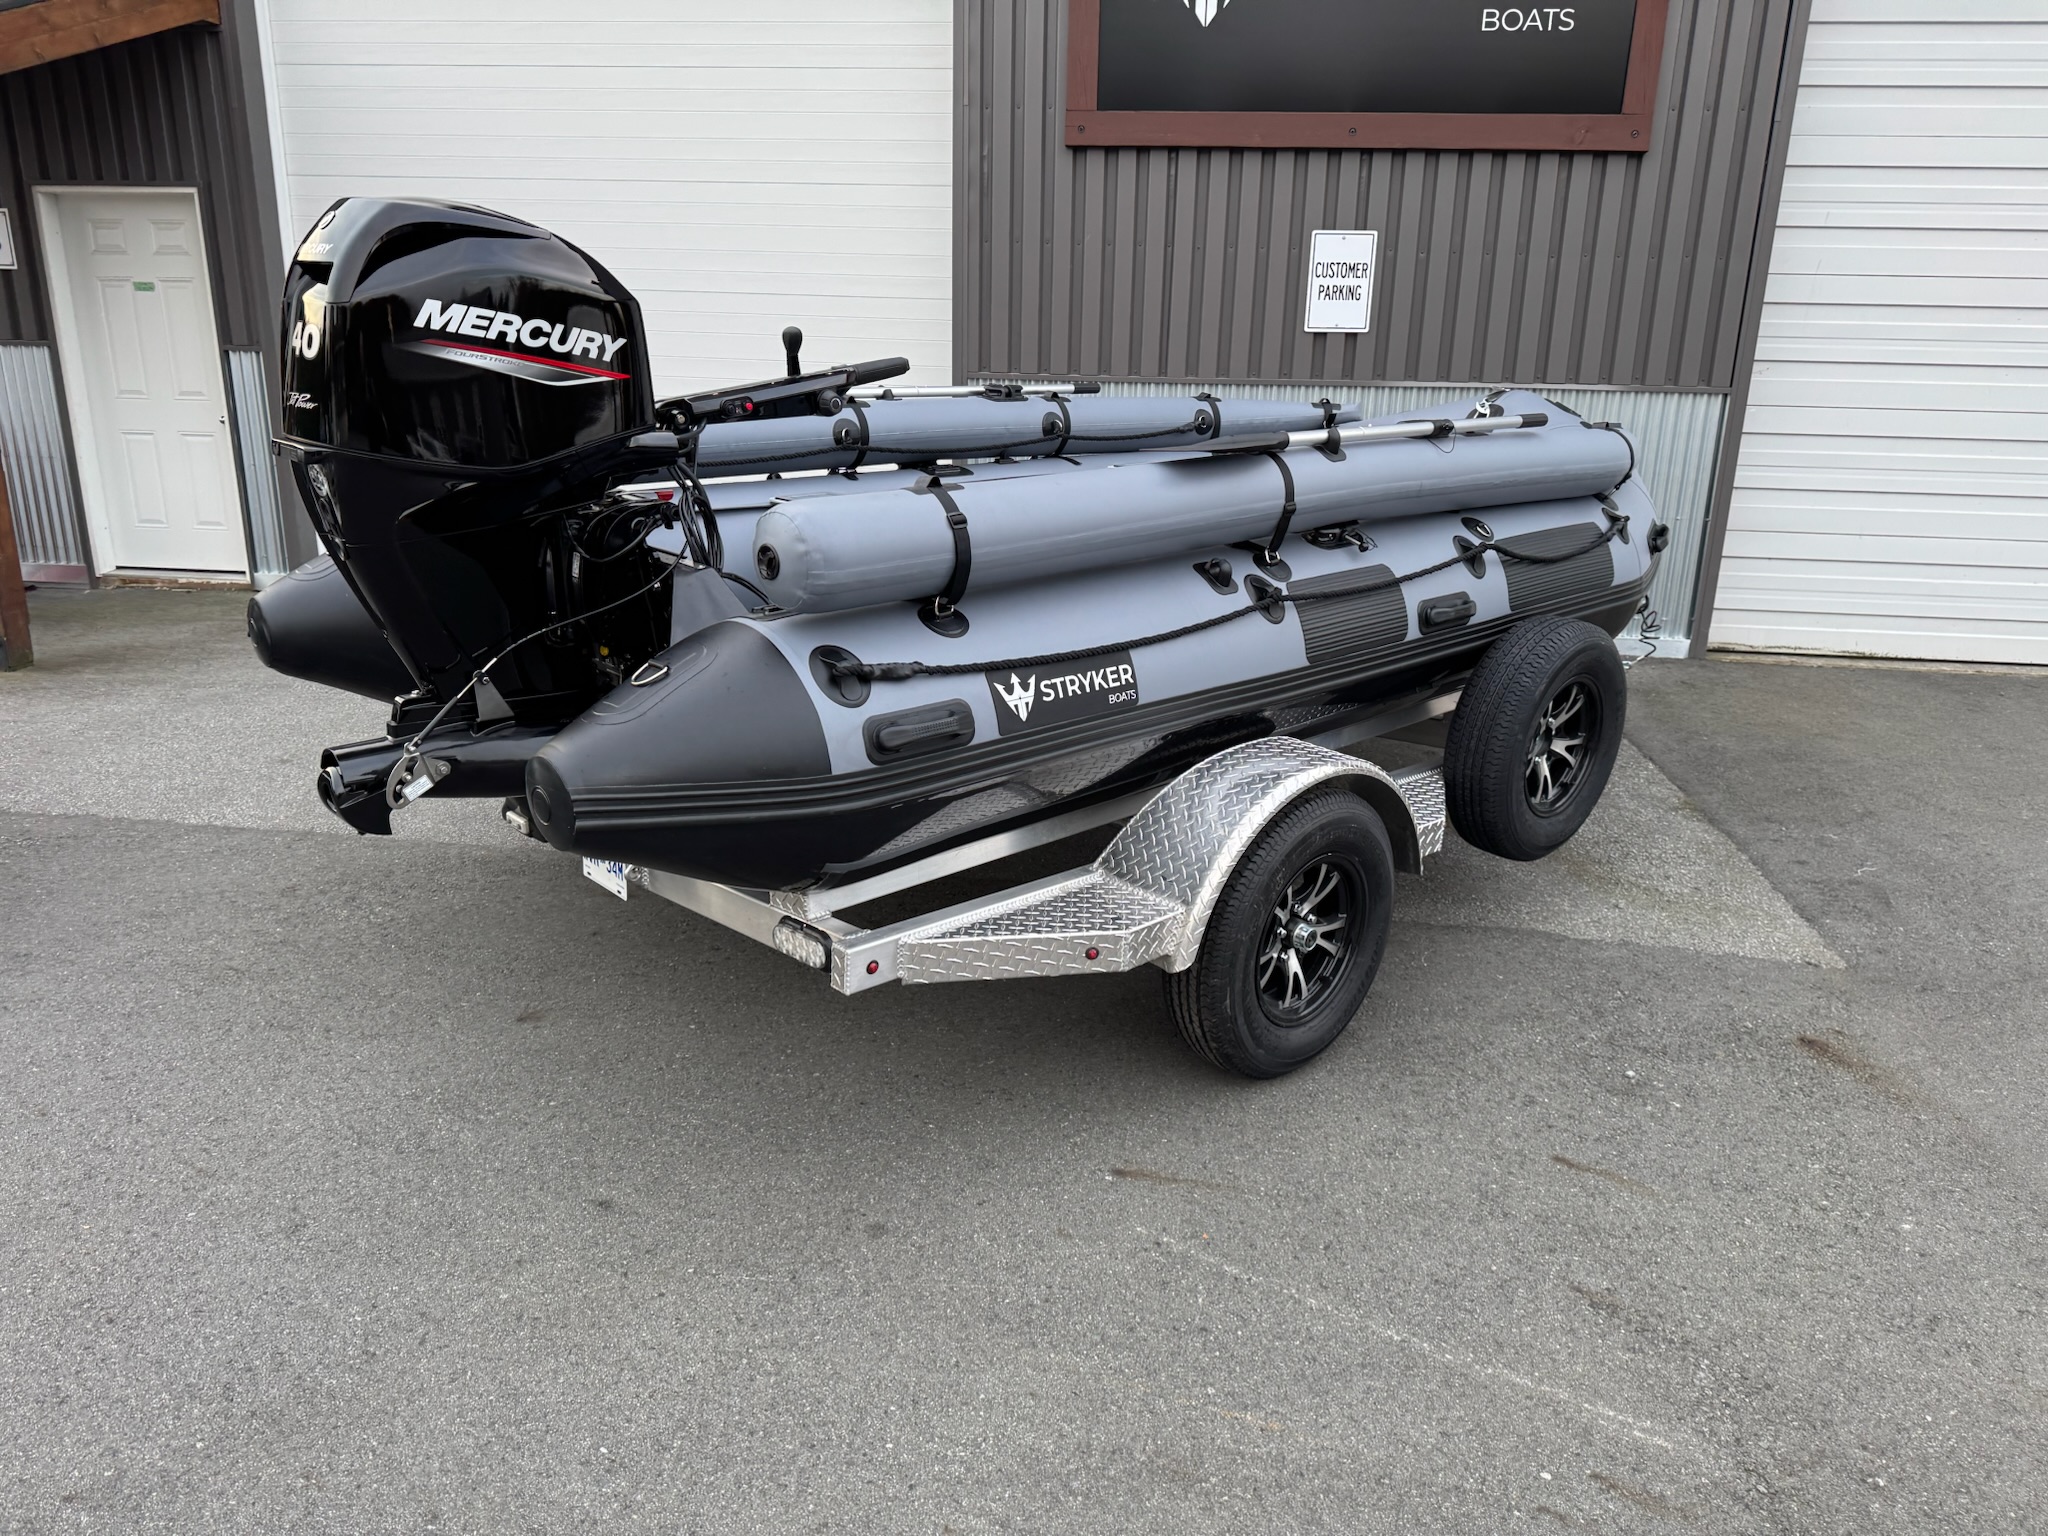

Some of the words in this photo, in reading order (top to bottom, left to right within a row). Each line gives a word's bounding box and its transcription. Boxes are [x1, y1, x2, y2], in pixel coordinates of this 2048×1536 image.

[1481, 8, 1575, 31] BOATS
[1315, 261, 1369, 279] CUSTOMER
[1317, 284, 1362, 301] PARKING
[291, 320, 321, 360] 40
[413, 298, 627, 362] MERCURY
[1039, 663, 1135, 702] STRYKER
[1108, 689, 1137, 704] BOATS
